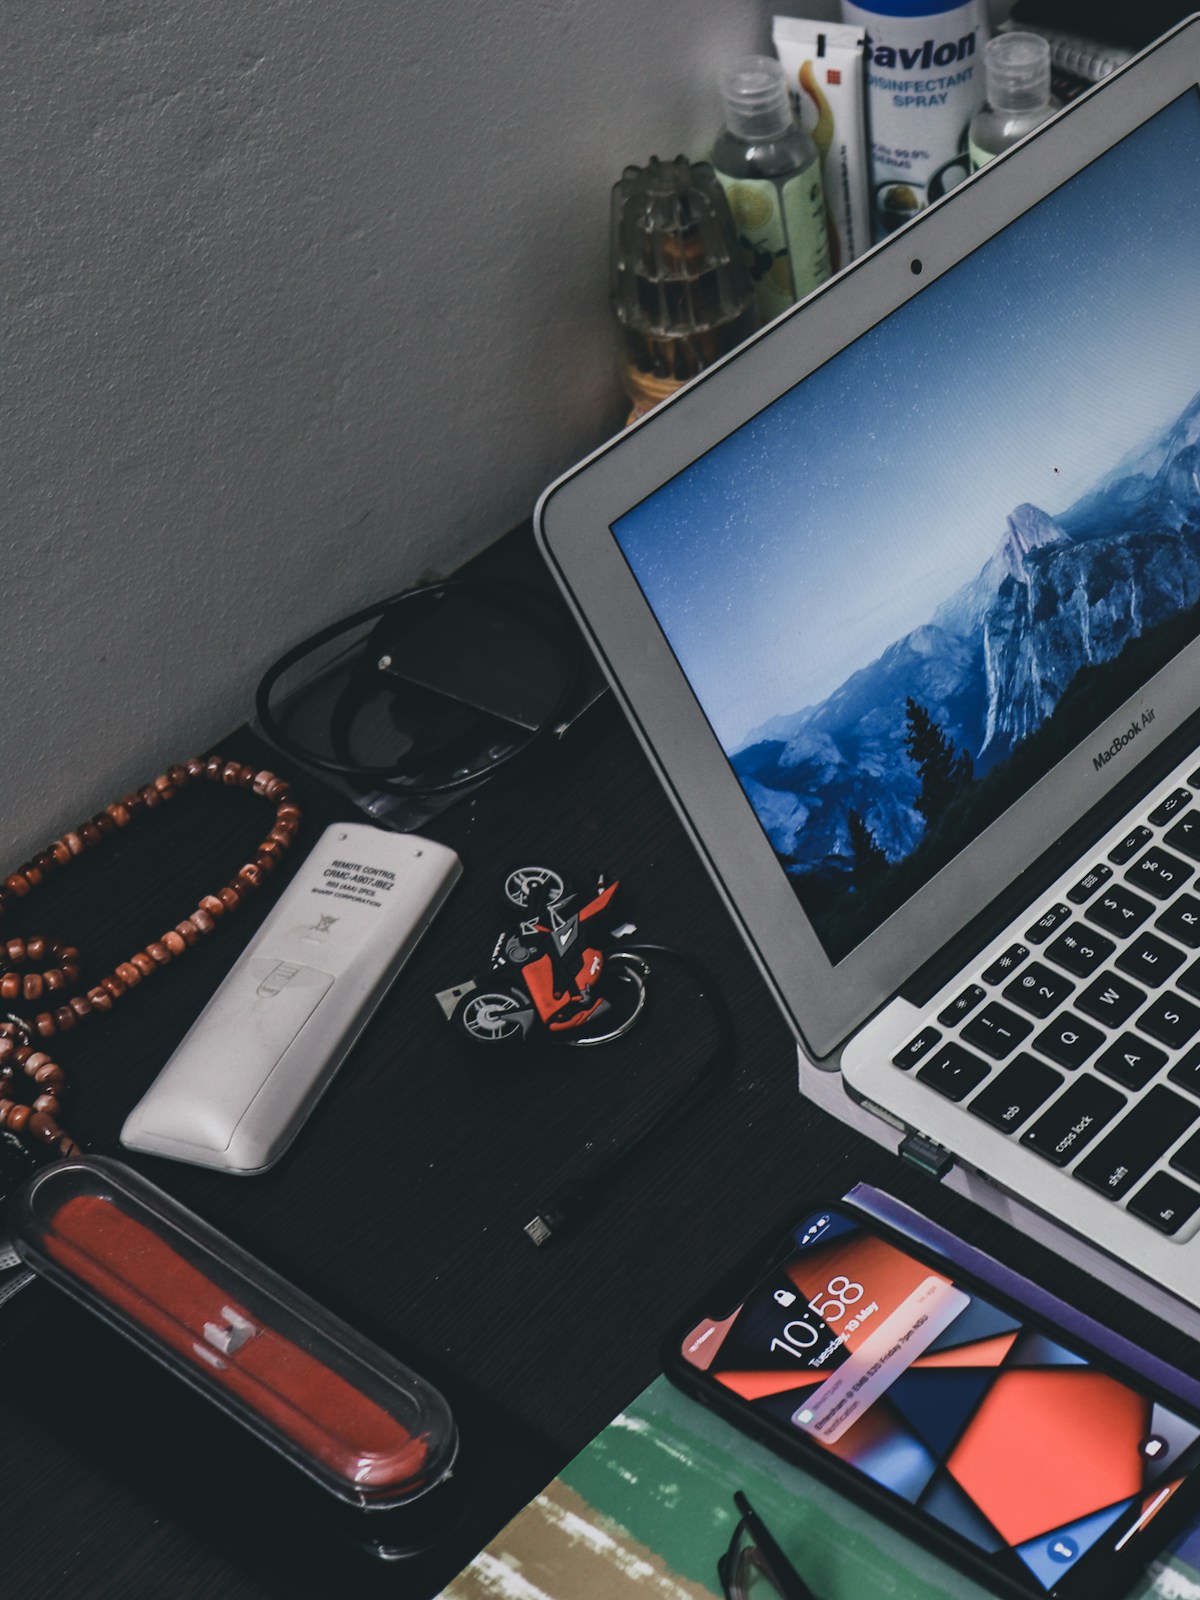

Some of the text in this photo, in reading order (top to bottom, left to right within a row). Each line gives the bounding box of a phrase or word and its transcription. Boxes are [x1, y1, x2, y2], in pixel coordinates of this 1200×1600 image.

[893, 92, 949, 107] SPRAY
[1092, 708, 1156, 772] MacBook Air
[331, 860, 396, 880] REMOTE CONTROL
[1160, 870, 1173, 881] 5
[311, 887, 382, 908] SHARP CORPORATION
[1122, 908, 1134, 918] 4
[1181, 913, 1198, 924] R
[1081, 946, 1095, 958] 3
[1142, 952, 1158, 963] E
[1023, 977, 1036, 987] @
[1039, 987, 1054, 998] 2
[1099, 988, 1119, 1004] W
[1165, 1012, 1179, 1023] S
[996, 1027, 1012, 1037] 1
[1061, 1032, 1079, 1044] Q
[911, 1039, 925, 1052] esc
[1124, 1054, 1140, 1066] A
[1003, 1106, 1019, 1120] tab
[1056, 1116, 1094, 1152] caps lock
[1109, 1167, 1128, 1186] shift
[1160, 1210, 1174, 1220] fn
[770, 1275, 865, 1358] 10:58
[808, 1301, 880, 1368] Tuesday, 19 May
[879, 1341, 902, 1365] Friday
